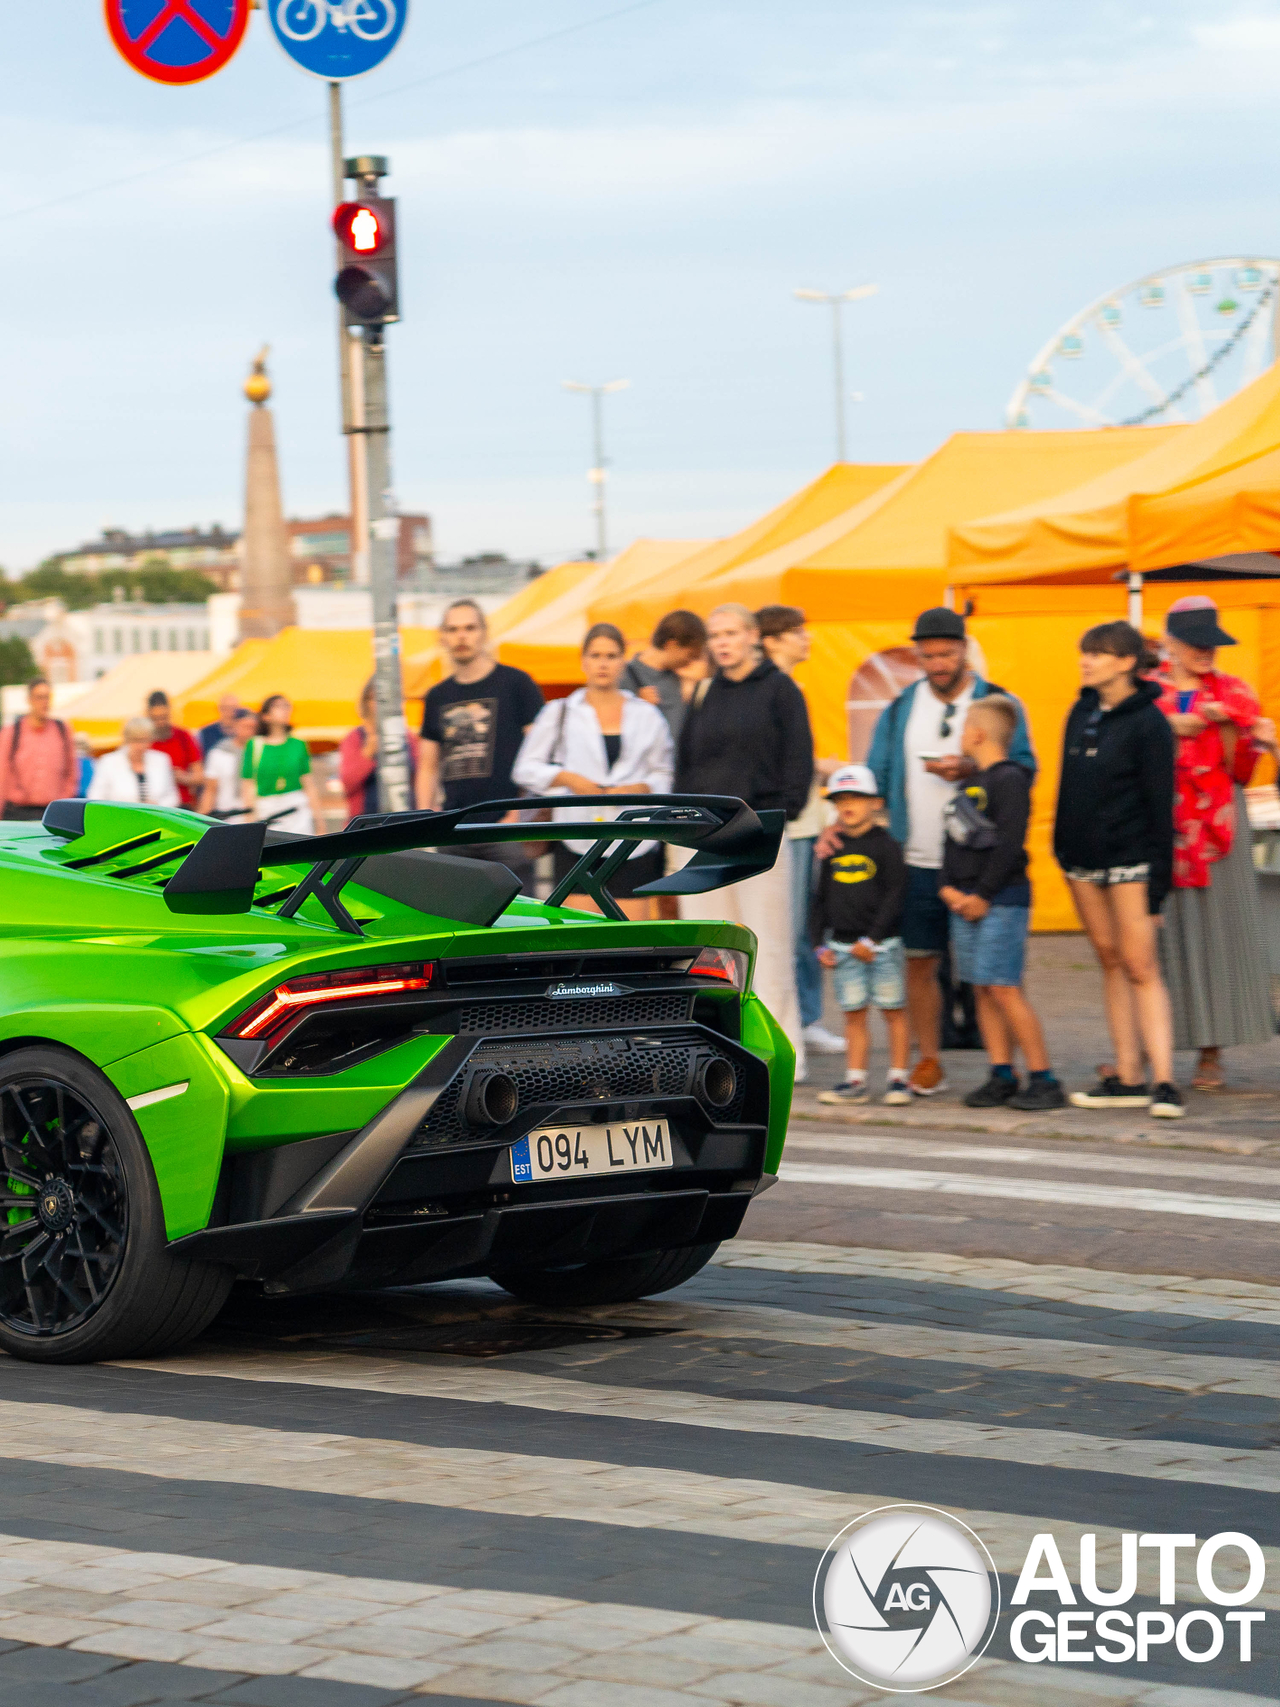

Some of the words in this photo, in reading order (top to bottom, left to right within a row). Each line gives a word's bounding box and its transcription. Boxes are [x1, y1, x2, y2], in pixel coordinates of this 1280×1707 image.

[552, 983, 614, 996] Lamborghini
[537, 1132, 589, 1172] 094
[606, 1124, 665, 1166] LYM
[515, 1163, 530, 1175] EST
